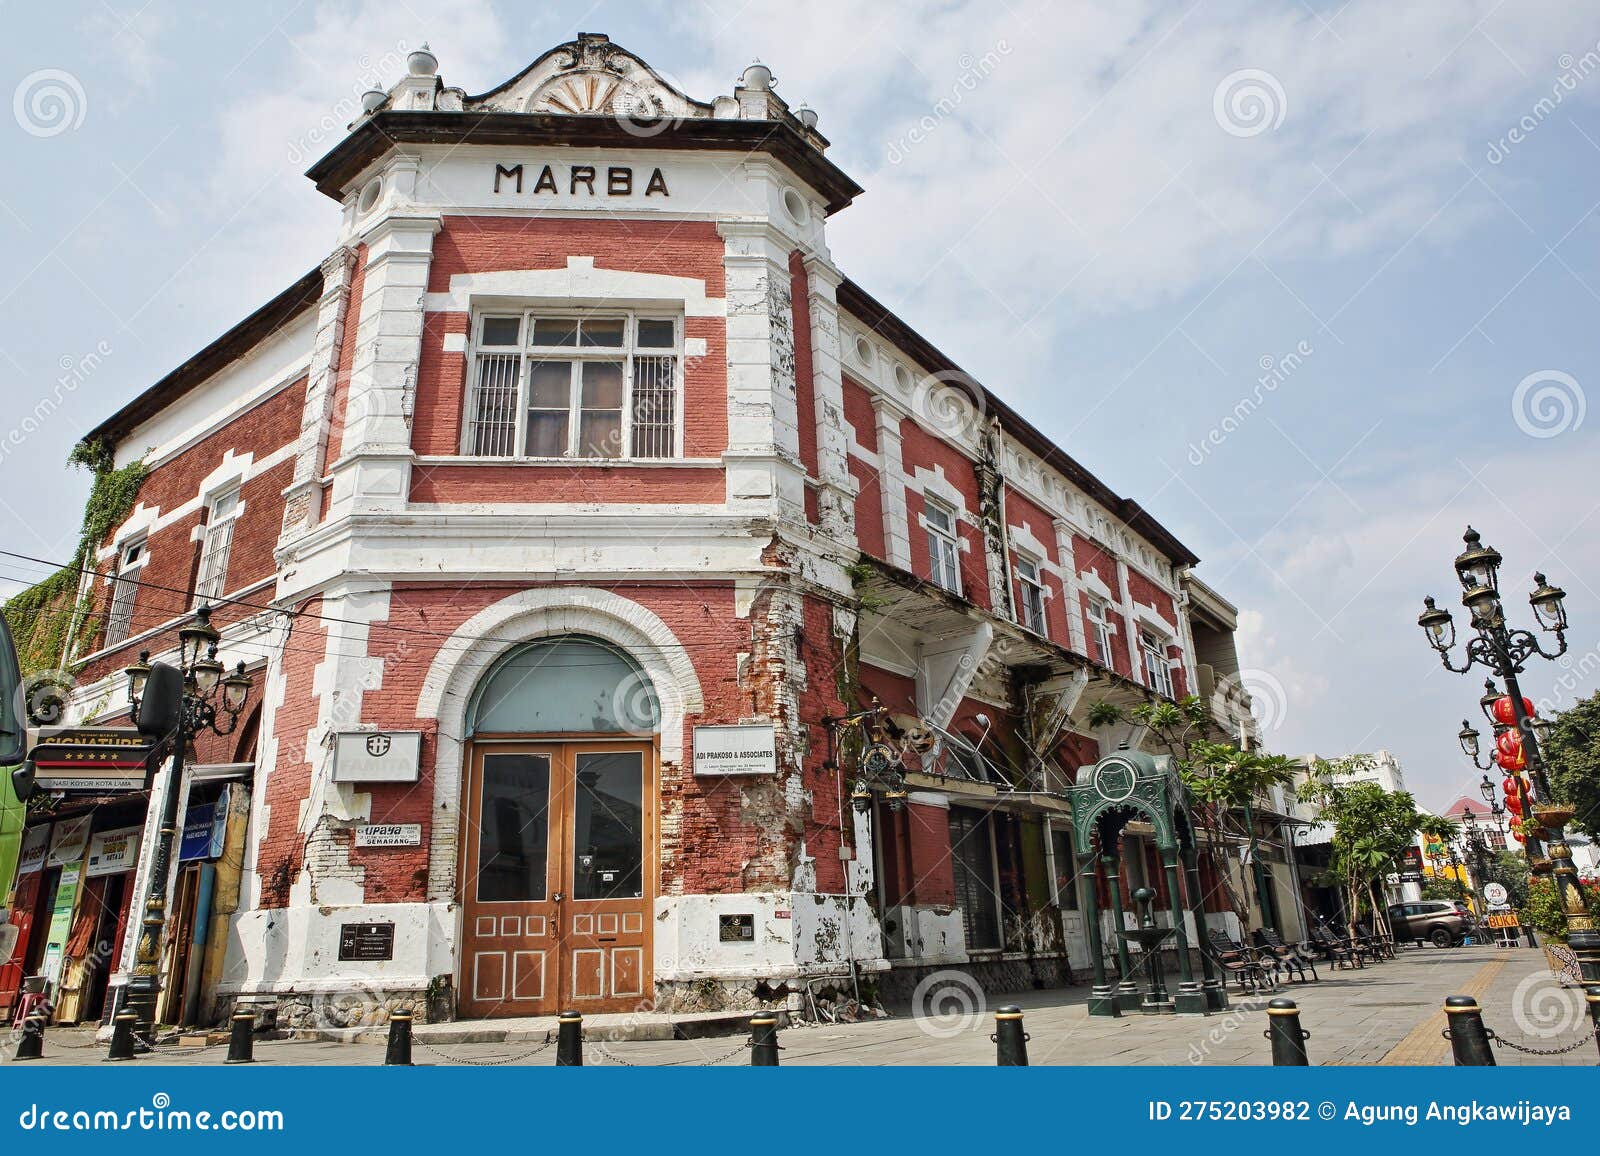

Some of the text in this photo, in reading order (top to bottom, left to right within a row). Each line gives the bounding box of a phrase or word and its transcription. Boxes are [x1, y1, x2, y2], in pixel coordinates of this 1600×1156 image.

[493, 164, 669, 196] MARBA
[707, 752, 733, 760] PRAKOSO
[1489, 915, 1518, 928] BUKA
[344, 939, 354, 947] 25
